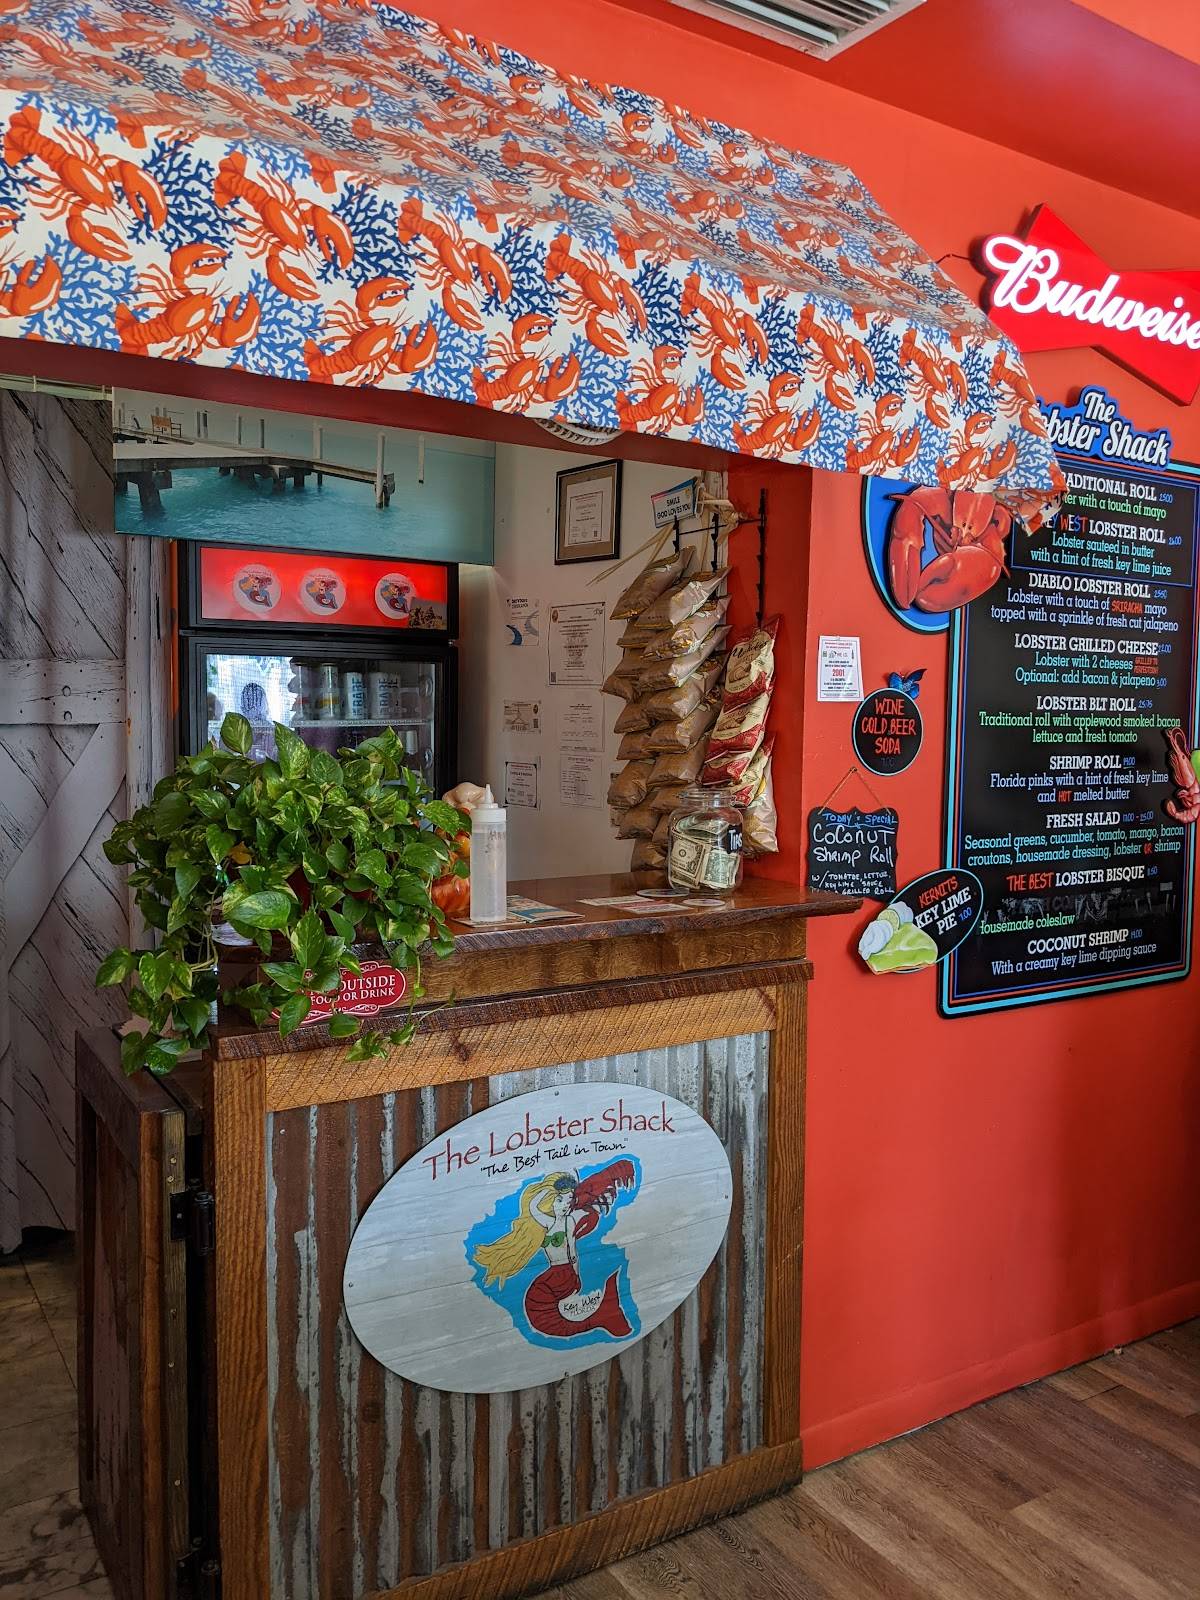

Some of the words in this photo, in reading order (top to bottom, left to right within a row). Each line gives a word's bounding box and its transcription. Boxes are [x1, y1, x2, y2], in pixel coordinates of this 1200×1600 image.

[1084, 391, 1116, 422] The
[1102, 421, 1169, 465] Shack
[1129, 483, 1157, 501] ROLL
[1079, 493, 1097, 507] with
[1099, 500, 1106, 510] a
[1107, 498, 1131, 513] touch
[1133, 501, 1142, 515] of
[1143, 506, 1167, 521] mayo
[1046, 512, 1059, 529] EY
[1060, 514, 1088, 532] WEST
[1089, 519, 1137, 540] LOBSTER
[1139, 527, 1166, 543] ROLL
[1052, 531, 1085, 549] Lobster
[1086, 539, 1119, 553] sauteed
[1122, 541, 1129, 555] in
[1131, 542, 1155, 558] butter
[1030, 548, 1050, 562] with
[1052, 552, 1060, 560] a
[1061, 551, 1079, 565] hint
[1081, 554, 1090, 566] of
[1092, 555, 1113, 569] fresh
[1115, 556, 1130, 574] key
[1132, 558, 1150, 573] lime
[1151, 562, 1172, 577] juice
[1028, 573, 1072, 590] DIABLO
[1074, 577, 1122, 595] LOBSTER
[1123, 583, 1151, 599] ROLL
[1007, 588, 1043, 604] Lobster
[1045, 591, 1065, 607] with
[1066, 597, 1073, 607] a
[1074, 596, 1099, 610] touch
[1101, 596, 1110, 610] of
[1144, 604, 1167, 618] mayo
[991, 606, 1026, 622] topped
[1028, 606, 1047, 622] with
[1049, 612, 1057, 621] a
[1058, 610, 1094, 627] sprinkle
[1096, 612, 1106, 626] of
[1106, 614, 1128, 628] fresh
[1129, 616, 1141, 629] cut
[1142, 616, 1179, 633] jalapeno
[1014, 633, 1067, 649] LOBSTER
[1069, 636, 1115, 653] GRILLED
[1117, 639, 1159, 656] CHEESE
[1035, 651, 1069, 667] Lobster
[1071, 653, 1090, 668] with
[1092, 656, 1098, 668] 2
[1099, 655, 1133, 670] cheeses
[1015, 667, 1059, 685] Optional:
[1062, 670, 1079, 684] add
[1082, 670, 1109, 684] bacon
[1111, 672, 1118, 685] &
[1119, 672, 1155, 688] jalapeno
[875, 698, 905, 716] WINE
[1036, 696, 1087, 711] LOBSTER
[1089, 697, 1108, 711] BLT
[1109, 697, 1136, 712] ROLL
[861, 717, 887, 735] COLD
[890, 718, 916, 736] BEER
[979, 712, 1033, 727] Traditional
[1035, 713, 1050, 727] roll
[1052, 713, 1071, 727] with
[1073, 713, 1121, 730] applewood
[1123, 714, 1155, 727] smoked
[1157, 715, 1181, 728] bacon
[875, 737, 901, 755] SODA
[1033, 729, 1063, 743] lettuce
[1065, 728, 1083, 742] and
[1085, 729, 1107, 742] fresh
[1108, 730, 1138, 742] tomato
[1049, 755, 1092, 770] SHRIMP
[1094, 755, 1121, 769] ROLL
[990, 773, 1027, 788] Florida
[1028, 774, 1053, 790] pinks
[1056, 773, 1075, 787] with
[1077, 776, 1083, 785] a
[1085, 773, 1103, 785] hint
[1104, 772, 1113, 785] of
[1113, 771, 1134, 785] fresh
[1136, 771, 1150, 787] key
[1152, 770, 1168, 783] lime
[1037, 789, 1056, 803] and
[1058, 790, 1073, 803] HOT
[1073, 788, 1103, 801] melted
[1105, 786, 1130, 800] butter
[1046, 812, 1083, 828] FRESH
[1085, 811, 1120, 827] SALAD
[964, 833, 1011, 850] Seasonal
[1013, 835, 1048, 850] greens,
[1050, 829, 1094, 844] cucumber,
[1096, 829, 1127, 842] tomato,
[1129, 826, 1159, 840] mango,
[1160, 824, 1184, 837] bacon
[967, 852, 1013, 866] croutons,
[1015, 847, 1070, 863] housemade
[1072, 845, 1112, 860] dressing,
[1114, 843, 1141, 855] lobster
[1154, 840, 1181, 854] shrimp
[1006, 875, 1027, 892] THE
[1028, 872, 1054, 889] BEST
[1055, 869, 1105, 887] LOBSTER
[1106, 866, 1145, 882] BISQUE
[915, 906, 938, 929] KEY
[942, 886, 972, 913] LIME
[936, 913, 958, 935] PIE
[1036, 911, 1076, 928] coleslaw
[1027, 934, 1086, 955] COCONUT
[1088, 928, 1129, 947] SHRIMP
[991, 961, 1014, 975] With
[1016, 963, 1022, 972] a
[1024, 956, 1059, 973] creamy
[1061, 952, 1077, 967] key
[1078, 950, 1097, 964] lime
[1099, 946, 1131, 962] dipping
[1133, 943, 1157, 955] sauce
[343, 992, 358, 1001] OR
[361, 987, 396, 999] DRINK
[422, 1138, 480, 1181] The
[489, 1112, 595, 1158] Lobster
[600, 1099, 676, 1133] Shack
[513, 1153, 541, 1172] Best
[547, 1144, 570, 1161] Tail
[574, 1143, 590, 1155] in
[563, 1303, 578, 1312] Key
[581, 1291, 601, 1307] West
